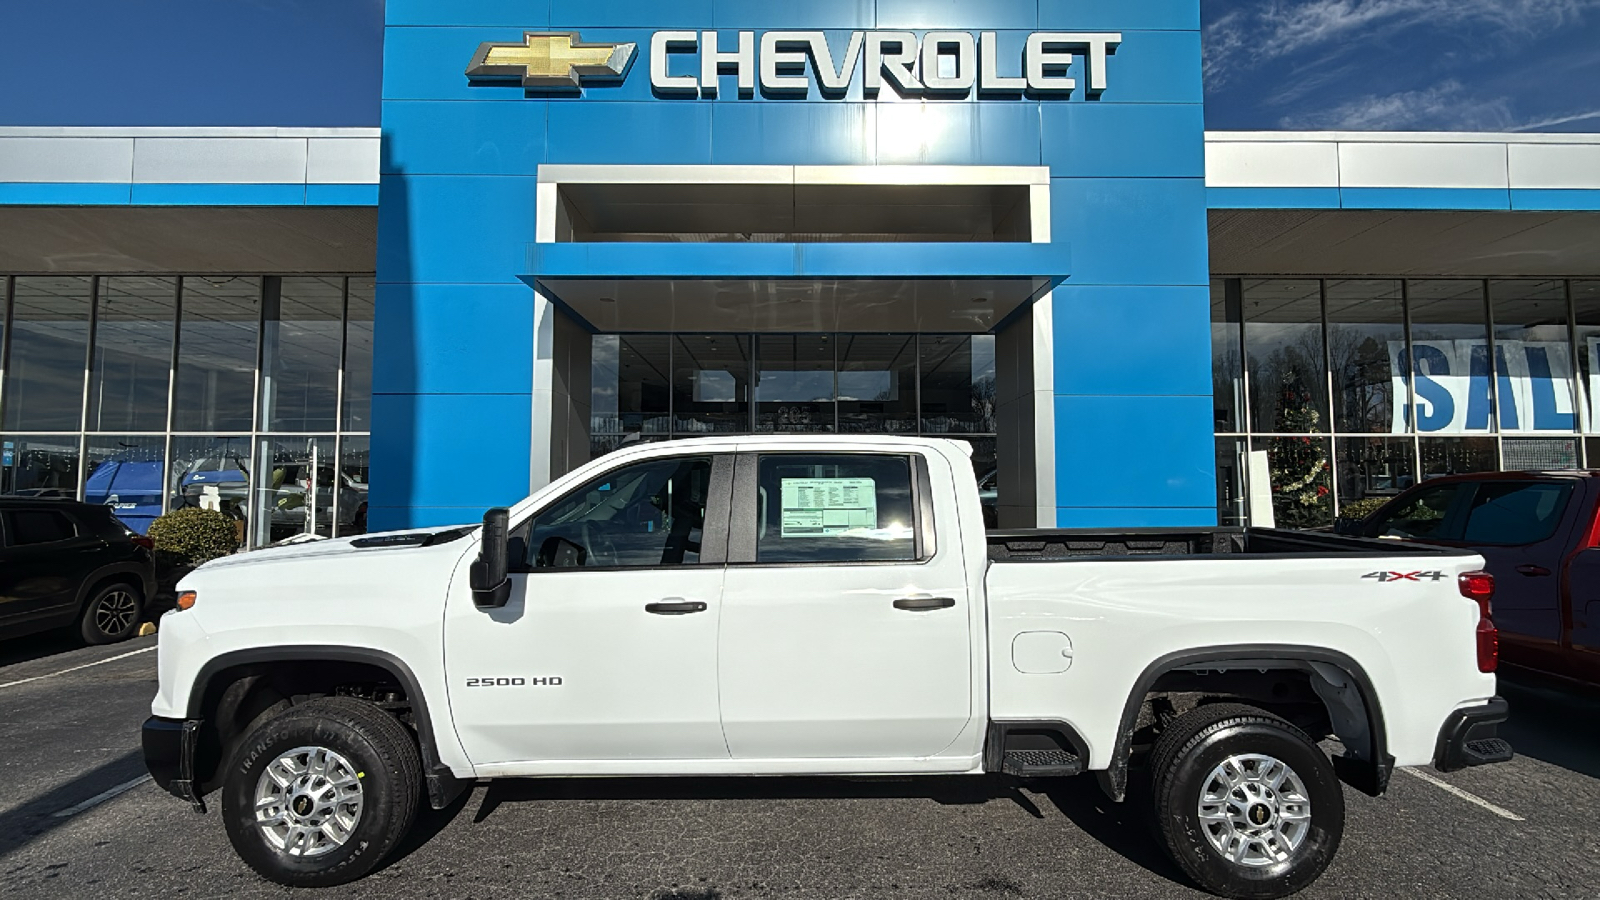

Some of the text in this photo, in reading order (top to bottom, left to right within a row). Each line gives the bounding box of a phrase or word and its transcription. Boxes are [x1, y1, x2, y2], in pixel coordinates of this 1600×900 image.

[650, 30, 1122, 97] CHEVROLET
[1397, 344, 1600, 432] SAL
[466, 677, 563, 687] 2500 HD
